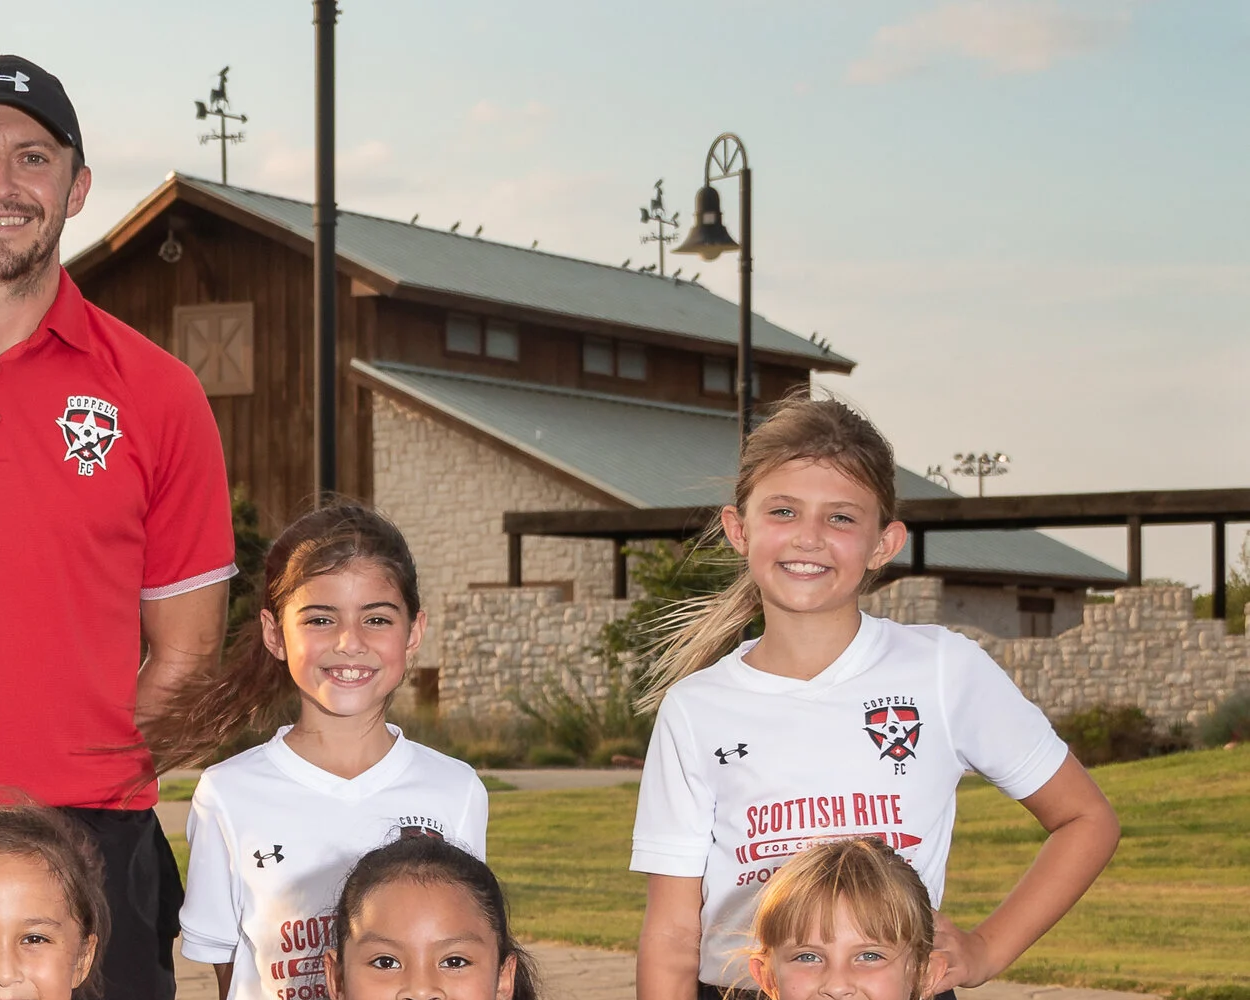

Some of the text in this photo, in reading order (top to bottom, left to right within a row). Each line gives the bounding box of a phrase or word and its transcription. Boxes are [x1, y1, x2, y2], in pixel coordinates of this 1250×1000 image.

[69, 398, 116, 417] COPPELL
[79, 462, 92, 475] FC
[863, 696, 916, 710] COPPELL
[893, 763, 906, 775] FC
[746, 793, 903, 838] SCOTTISH RITE
[399, 815, 444, 833] COPPELL
[764, 843, 789, 853] FOR
[736, 866, 781, 886] SPO
[280, 915, 338, 953] SCOT
[304, 960, 325, 971] FO
